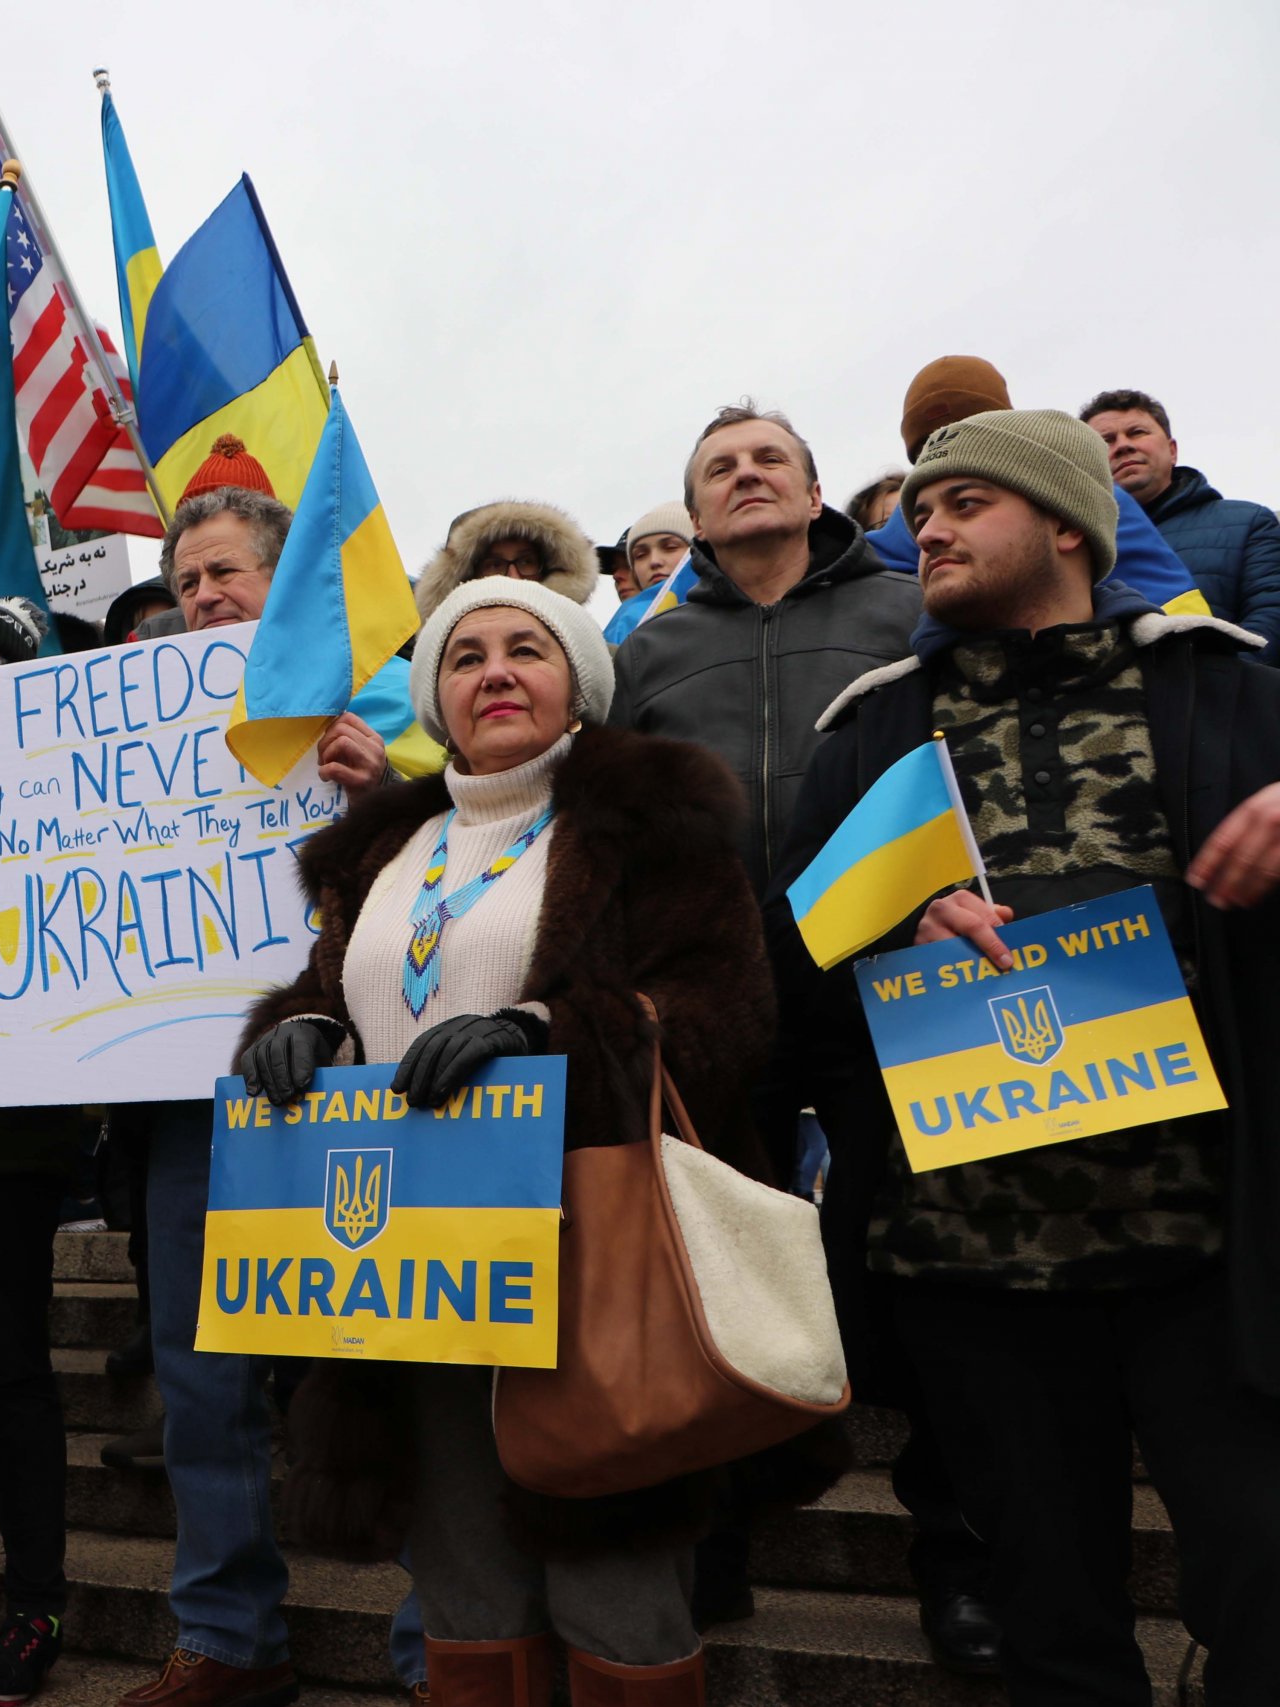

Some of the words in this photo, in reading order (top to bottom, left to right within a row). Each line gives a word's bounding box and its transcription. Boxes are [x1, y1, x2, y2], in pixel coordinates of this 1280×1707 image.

[14, 642, 248, 750] FREEDO
[19, 777, 62, 799] can
[71, 726, 283, 811] NEVE
[35, 816, 110, 853] Matter
[111, 806, 181, 847] What
[181, 804, 242, 849] They
[244, 798, 290, 830] Tell
[872, 971, 927, 1003] WE
[938, 943, 1048, 989] STAND
[1056, 913, 1151, 958] WITH
[225, 1097, 273, 1130] WE
[283, 1088, 411, 1125] STAND
[908, 1041, 1199, 1137] UKRAINE
[215, 1256, 534, 1325] UKRAINE
